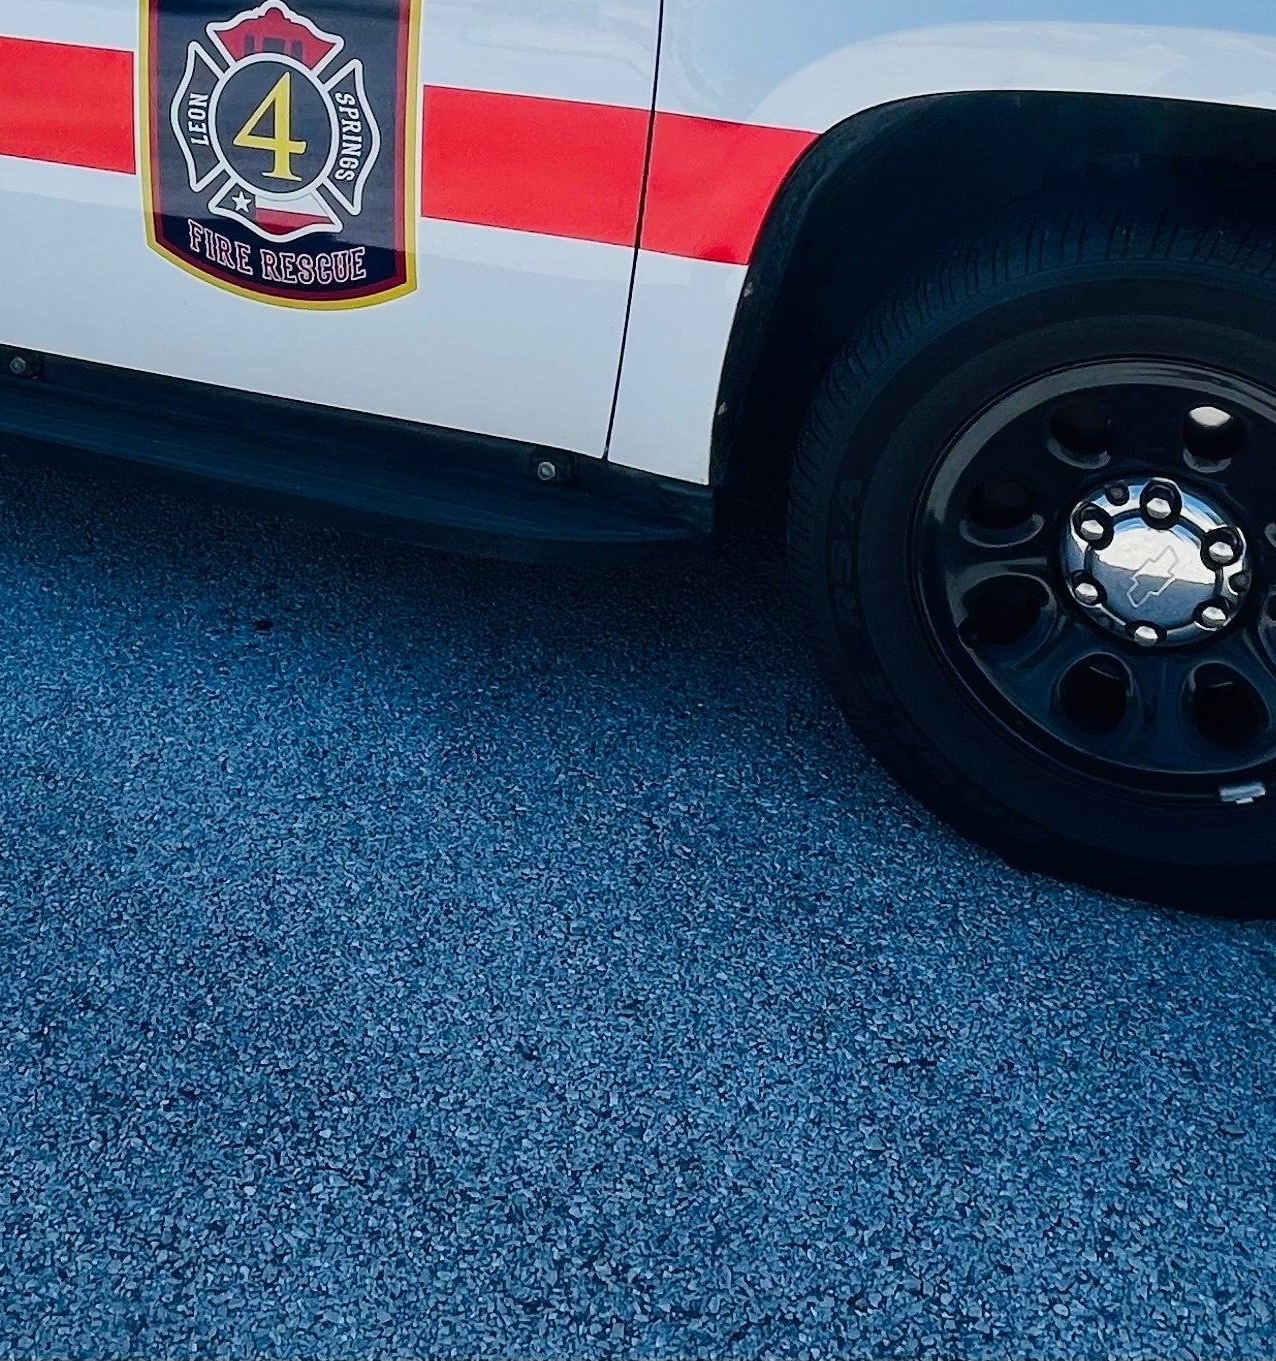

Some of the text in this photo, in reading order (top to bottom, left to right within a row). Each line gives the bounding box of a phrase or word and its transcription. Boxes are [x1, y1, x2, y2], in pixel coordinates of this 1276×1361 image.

[188, 91, 209, 147] LEON
[232, 71, 307, 182] 4
[334, 90, 362, 183] SPRINGS
[187, 218, 367, 286] FIRE RESCUE
